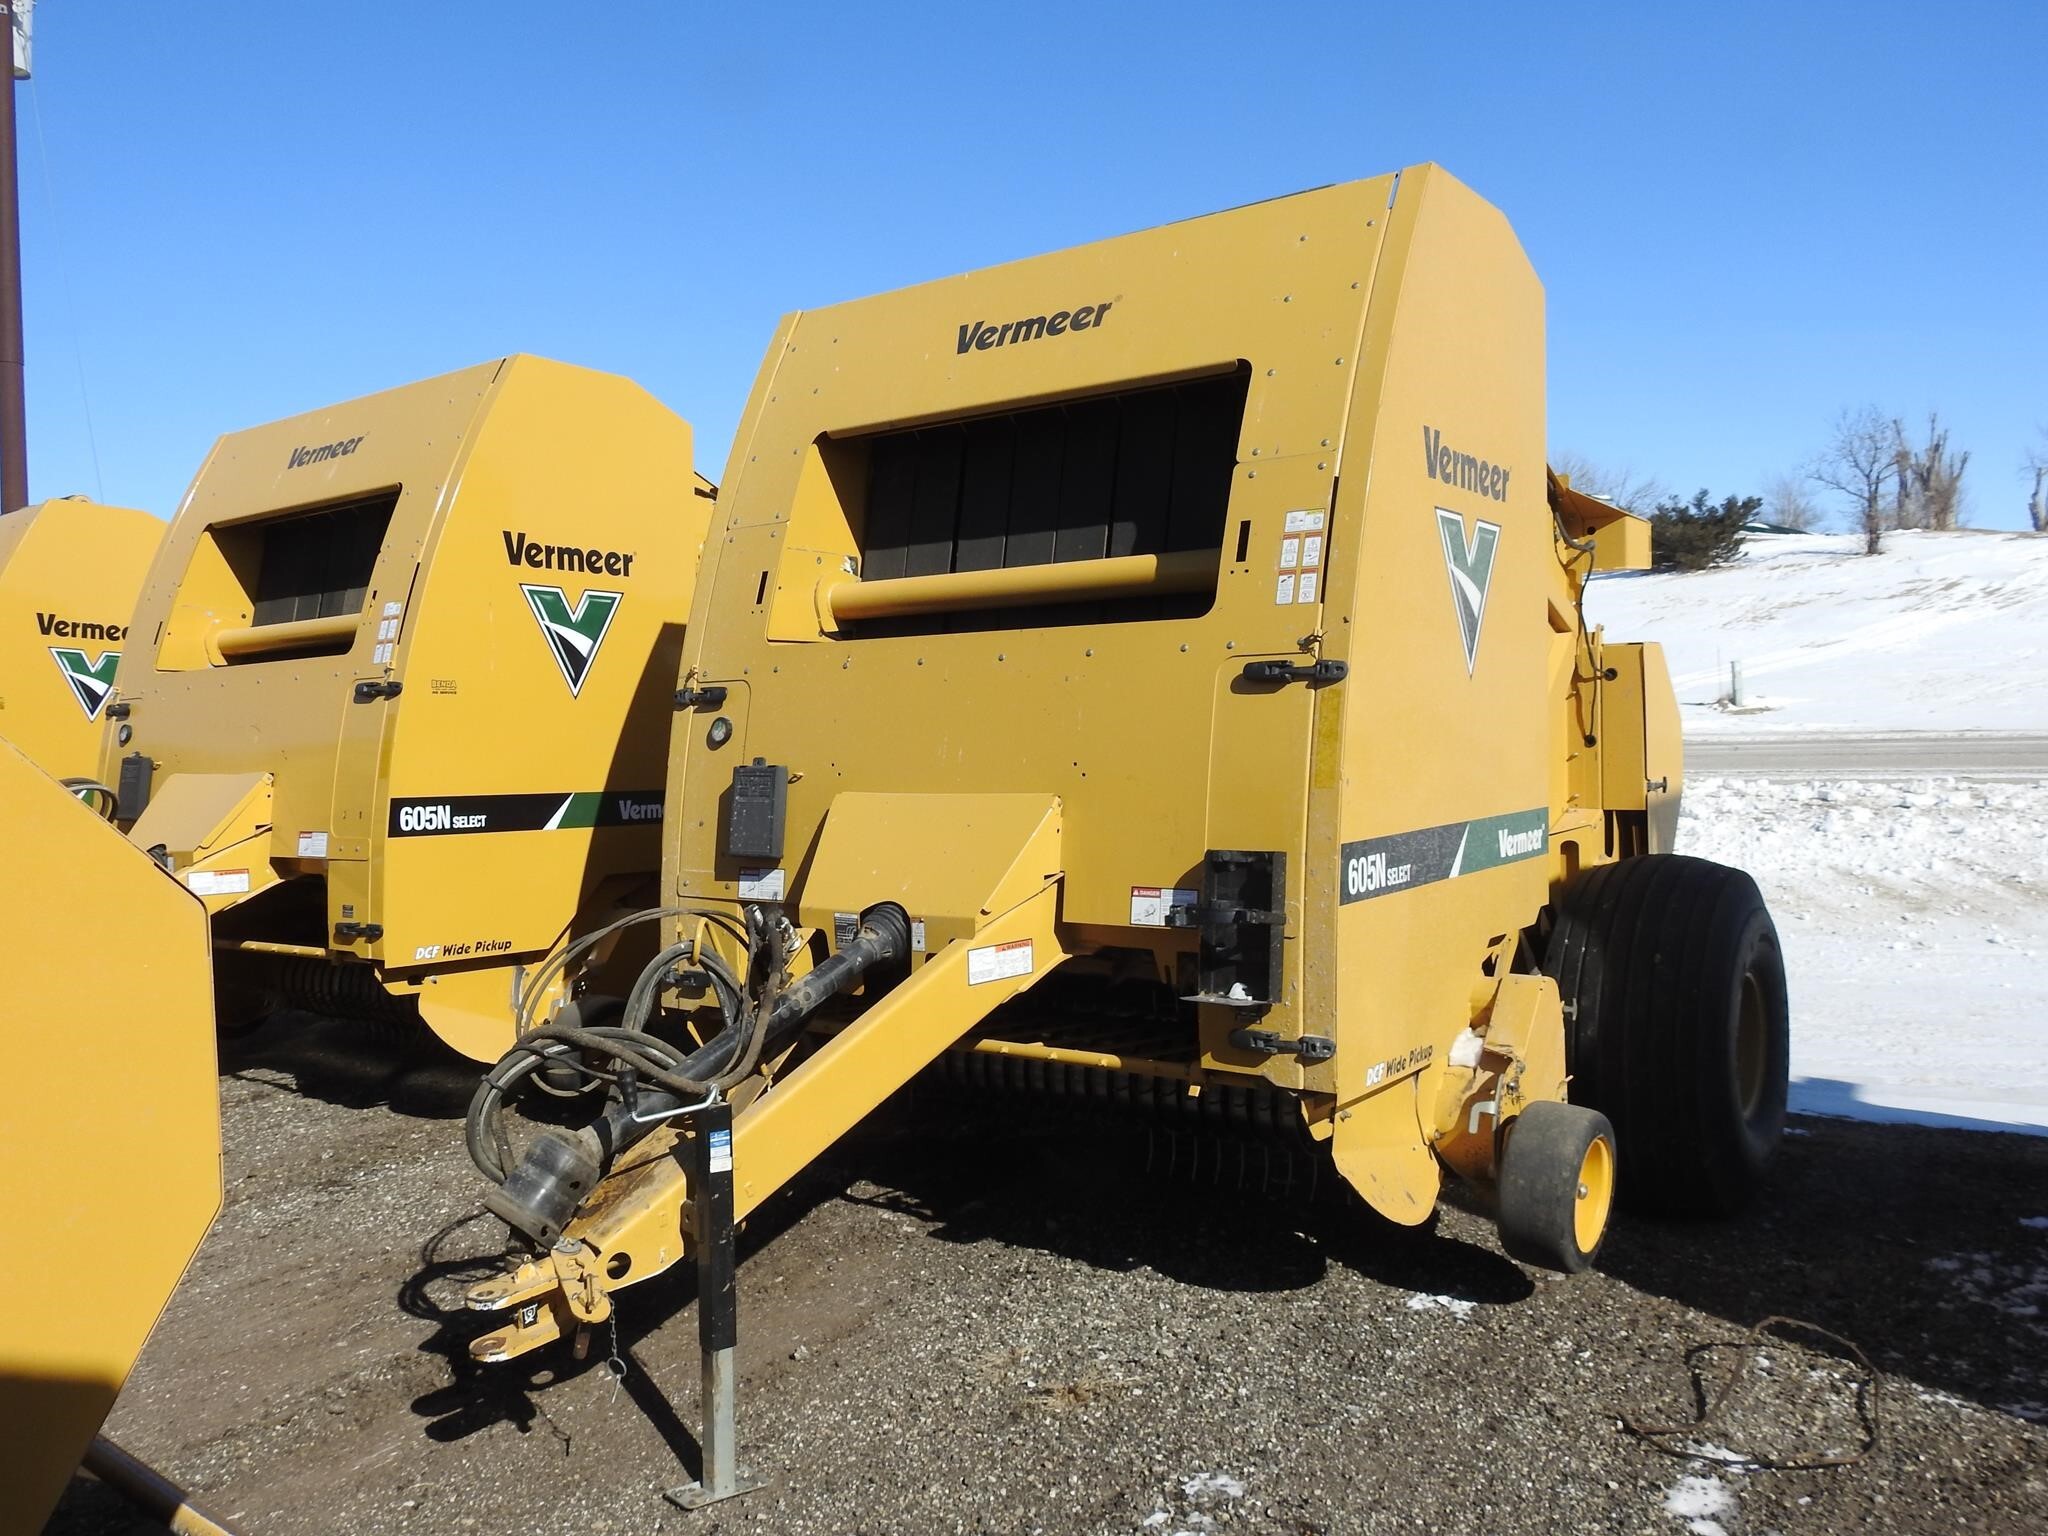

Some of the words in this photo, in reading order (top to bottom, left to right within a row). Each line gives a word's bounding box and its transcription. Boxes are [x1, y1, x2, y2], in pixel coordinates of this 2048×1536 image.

[956, 302, 1113, 355] Vermeer
[287, 436, 365, 470] Vermeer
[1422, 424, 1510, 503] Vermeer
[502, 530, 633, 577] Vermeer
[399, 804, 451, 831] 605N
[452, 815, 487, 828] SELECT
[618, 799, 664, 820] Verm
[1498, 828, 1544, 858] Vermeer
[1348, 852, 1386, 895] 605N
[1387, 864, 1411, 886] SELECT
[415, 945, 440, 960] DCF
[442, 943, 471, 957] Wide
[474, 940, 512, 953] Pickup
[1386, 1055, 1407, 1078] Wide
[1408, 1044, 1433, 1067] Pickup
